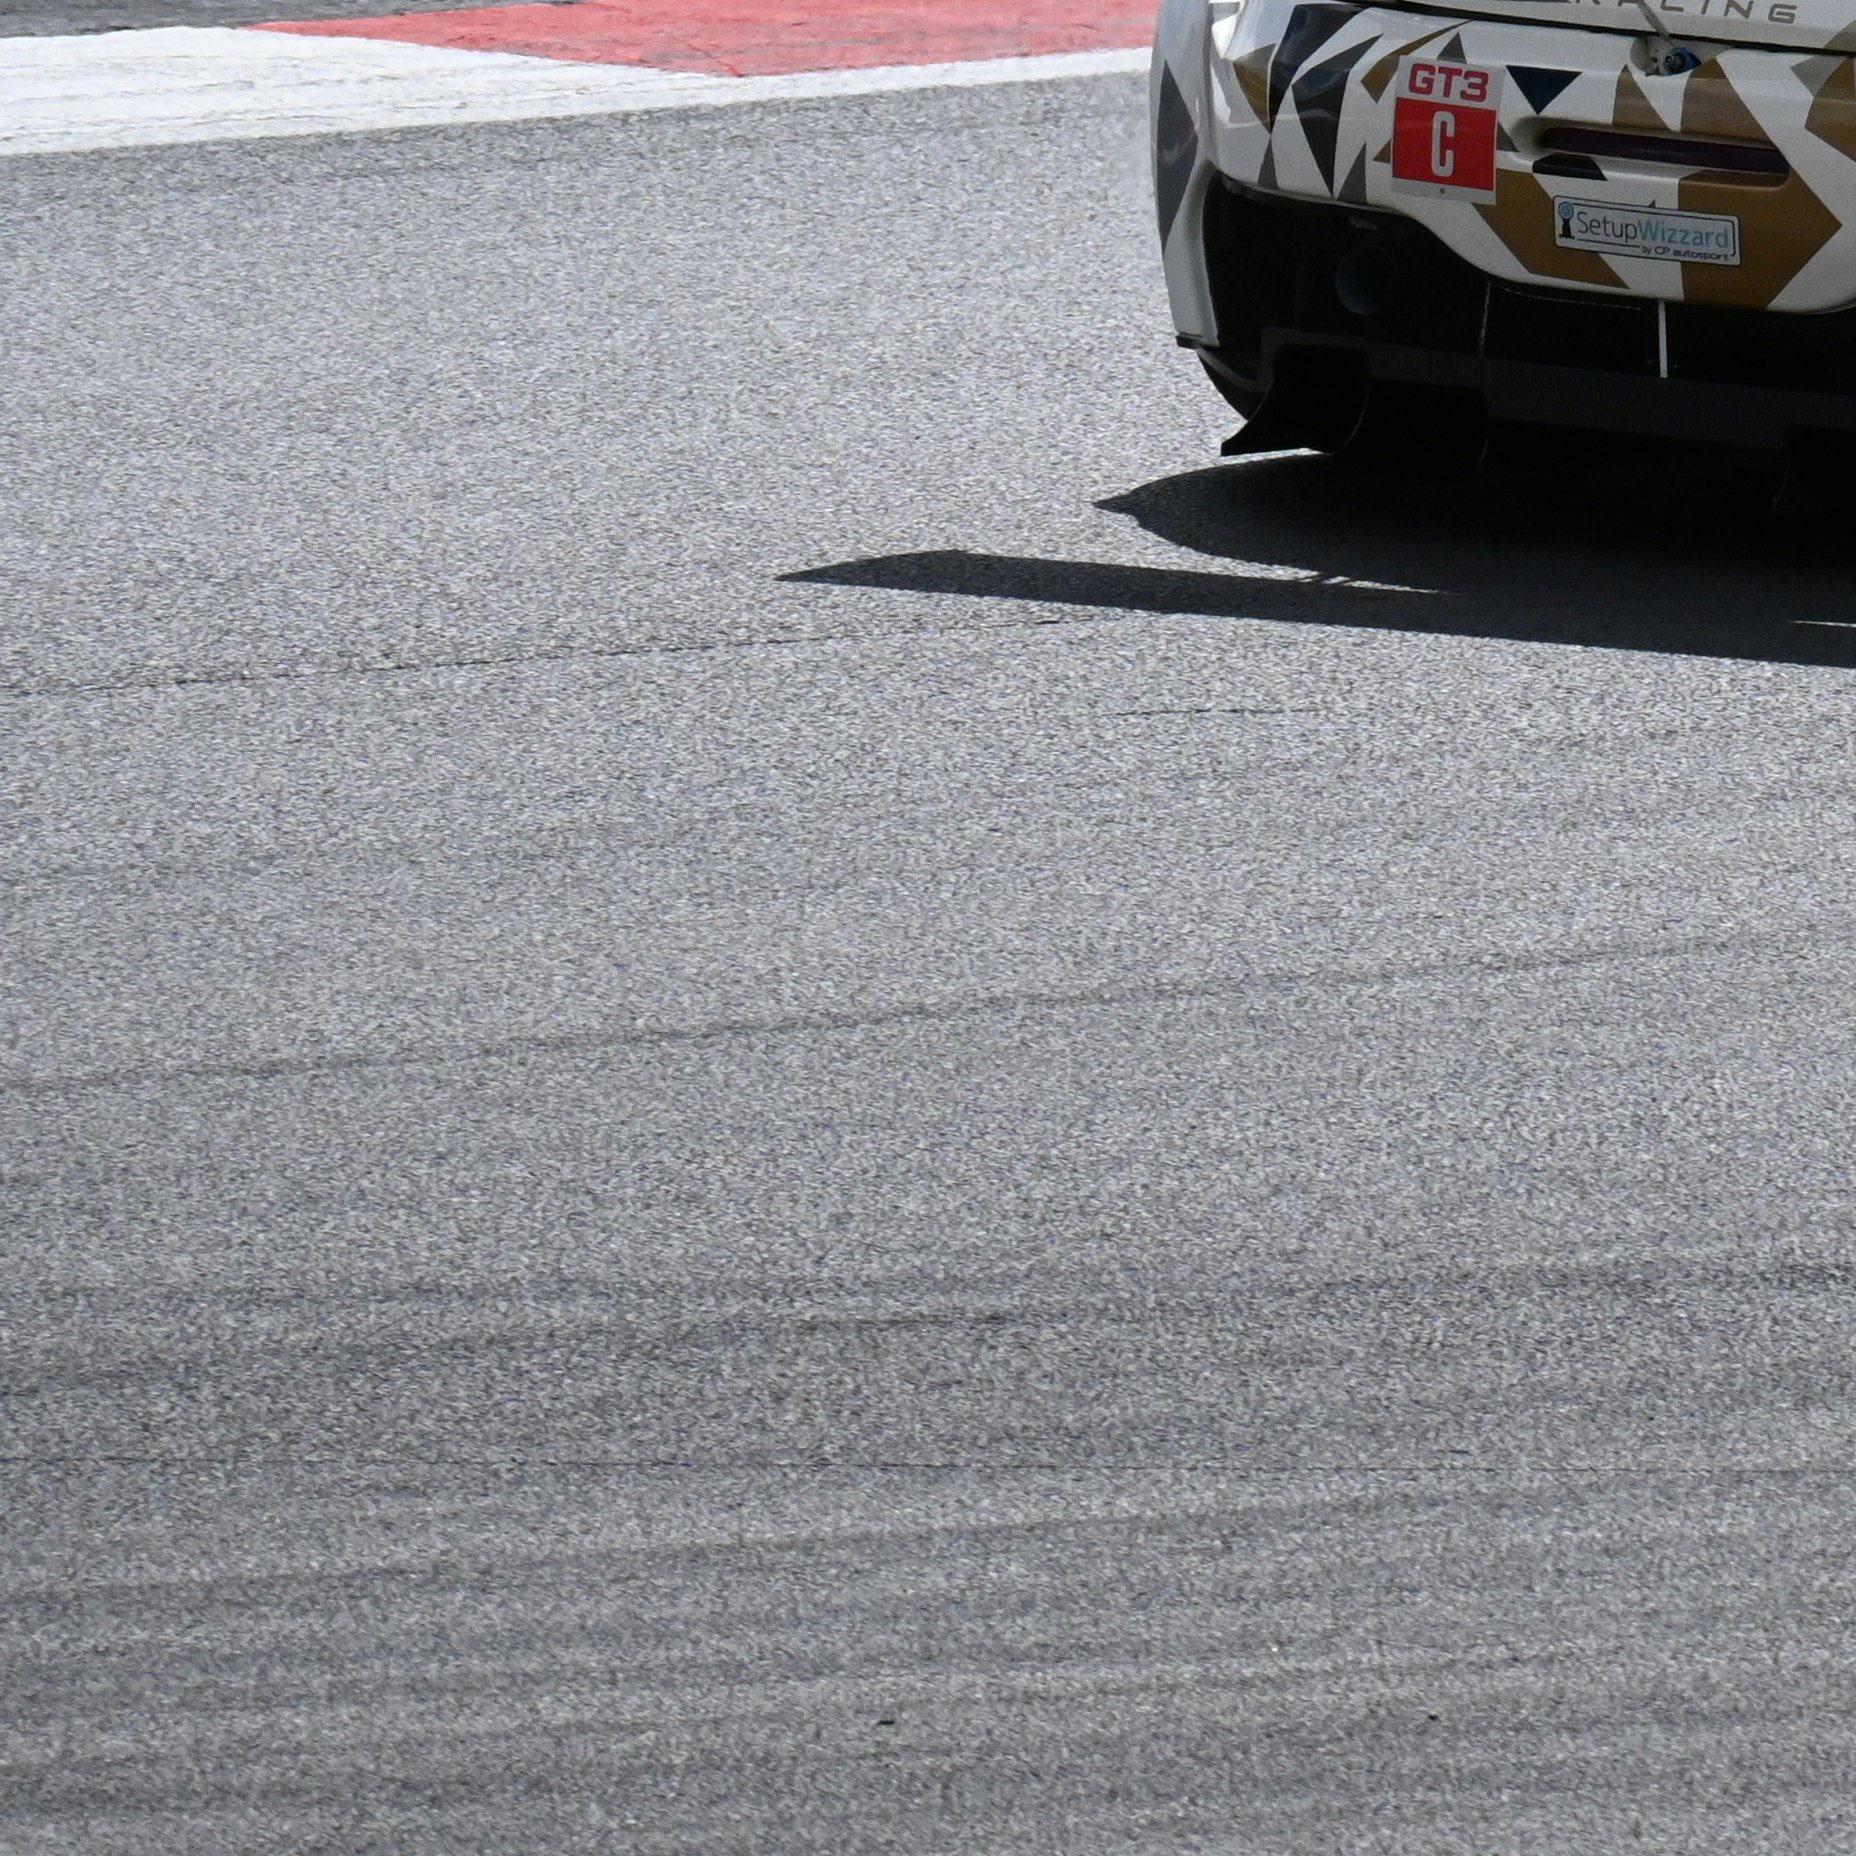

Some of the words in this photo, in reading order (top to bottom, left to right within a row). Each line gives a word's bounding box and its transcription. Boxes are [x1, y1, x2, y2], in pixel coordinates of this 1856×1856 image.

[1408, 63, 1490, 103] GT3
[1431, 110, 1456, 177] C
[1576, 211, 1729, 248] SetupWizzard
[1641, 245, 1651, 256] by
[1654, 246, 1670, 256] CP
[1673, 248, 1730, 262] autosport
